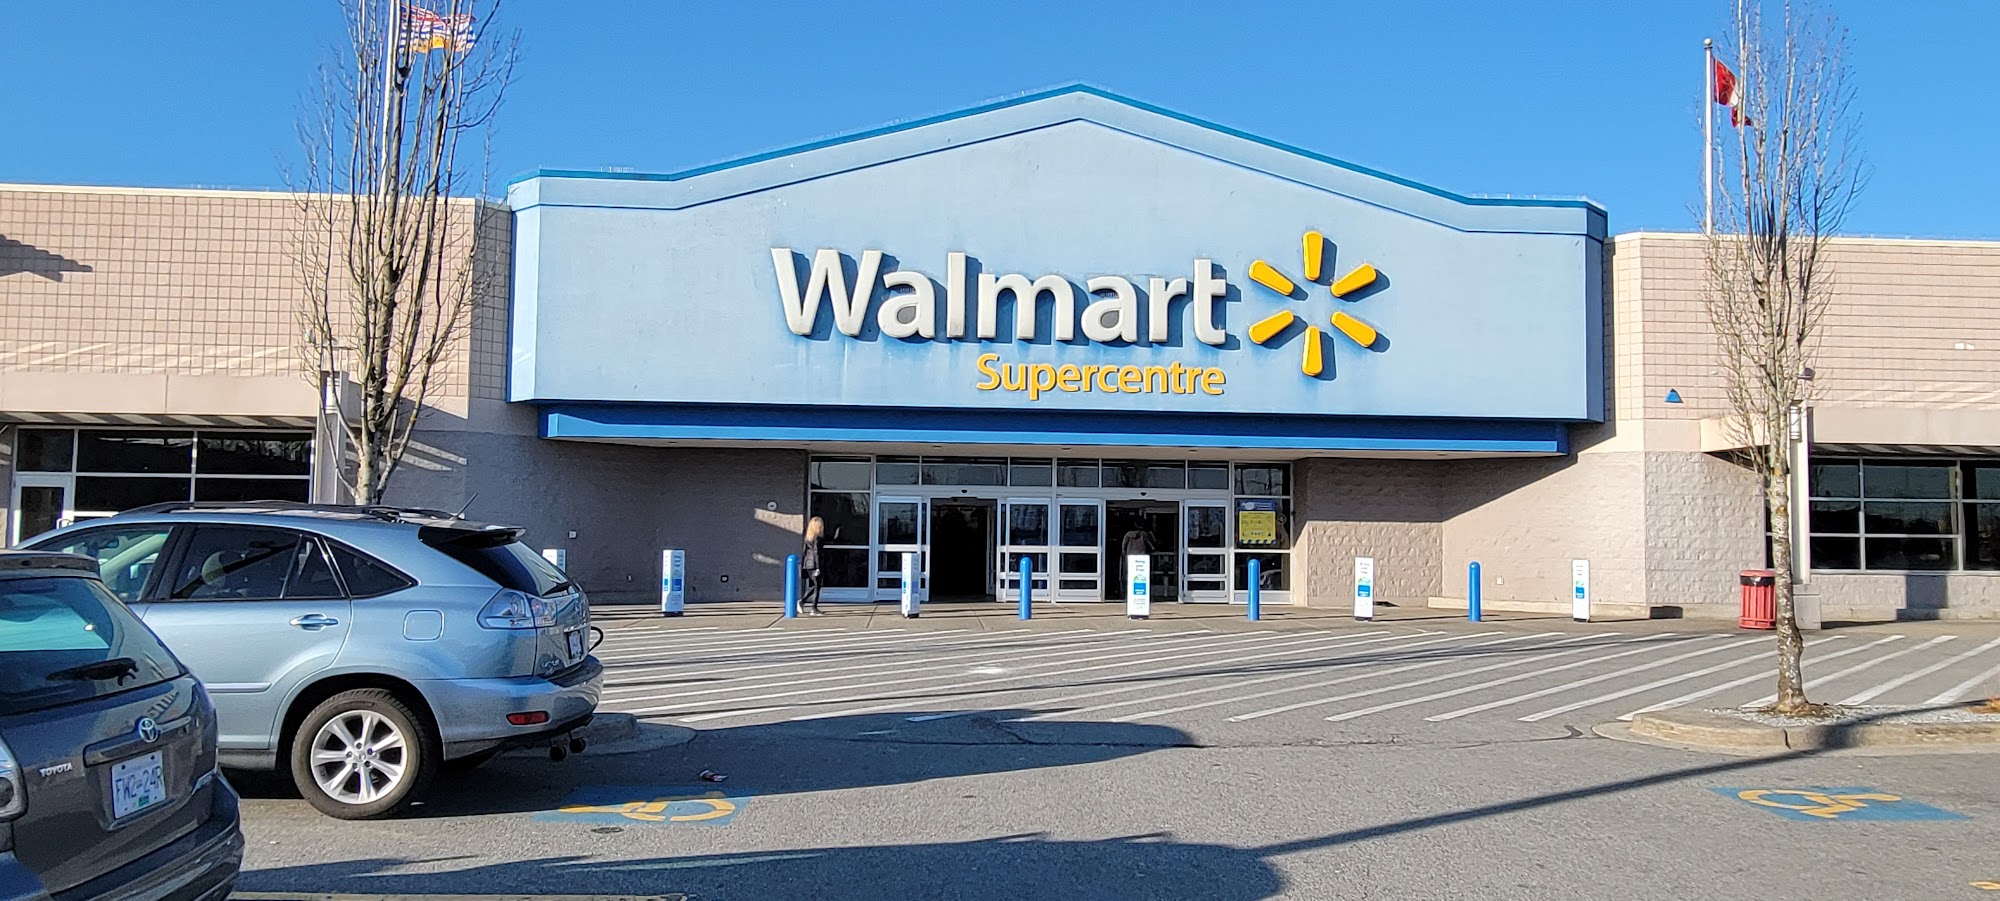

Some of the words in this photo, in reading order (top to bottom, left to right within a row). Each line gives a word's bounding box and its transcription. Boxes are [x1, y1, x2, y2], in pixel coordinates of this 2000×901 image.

[770, 246, 1227, 345] Walmart
[976, 353, 1226, 400] Supercentre
[38, 762, 74, 778] TOYOTA
